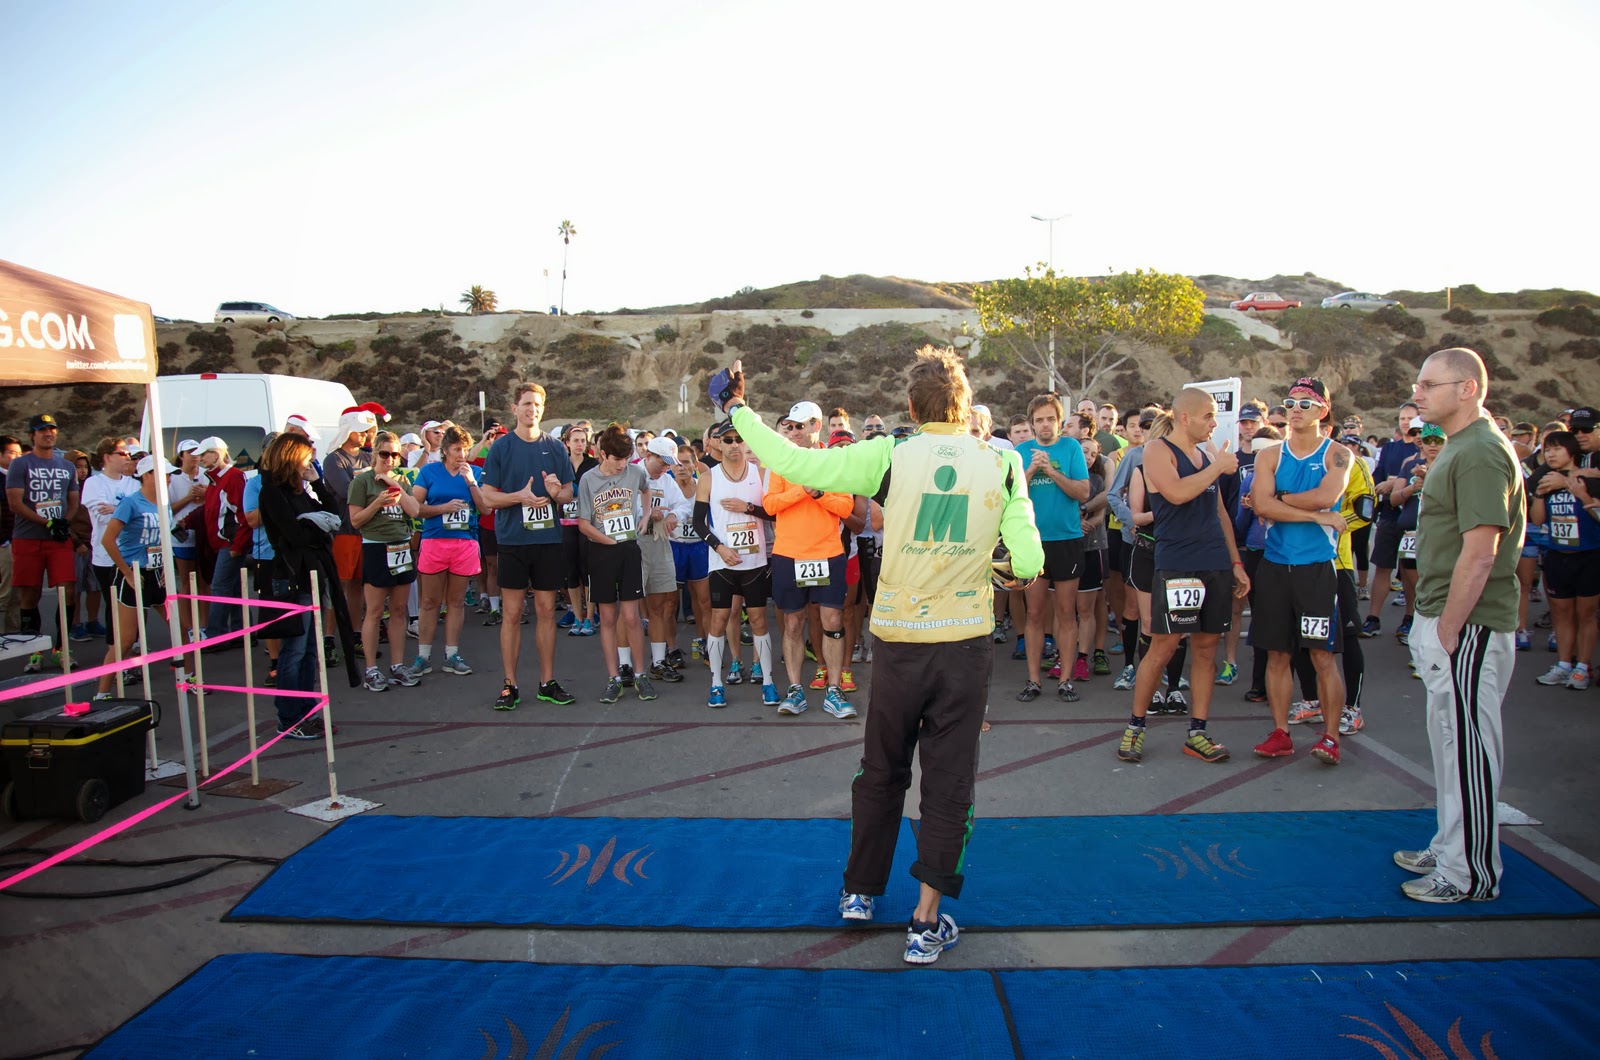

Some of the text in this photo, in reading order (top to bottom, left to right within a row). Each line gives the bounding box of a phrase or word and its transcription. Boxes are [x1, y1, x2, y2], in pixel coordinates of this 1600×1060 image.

[29, 468, 70, 479] NEVER
[30, 479, 61, 490] GIVE
[593, 488, 633, 508] SUMMIT
[1549, 493, 1576, 503] ASIA
[42, 507, 60, 520] 380
[447, 509, 467, 522] 246
[528, 504, 549, 521] 209
[1551, 504, 1574, 515] RUN
[608, 516, 630, 533] 210
[1554, 523, 1573, 537] 337
[732, 531, 755, 546] 228
[395, 551, 406, 565] 77
[800, 563, 824, 578] 231
[1174, 589, 1201, 606] 129
[873, 616, 984, 629] www.eventstores.com
[1302, 618, 1328, 636] 375
